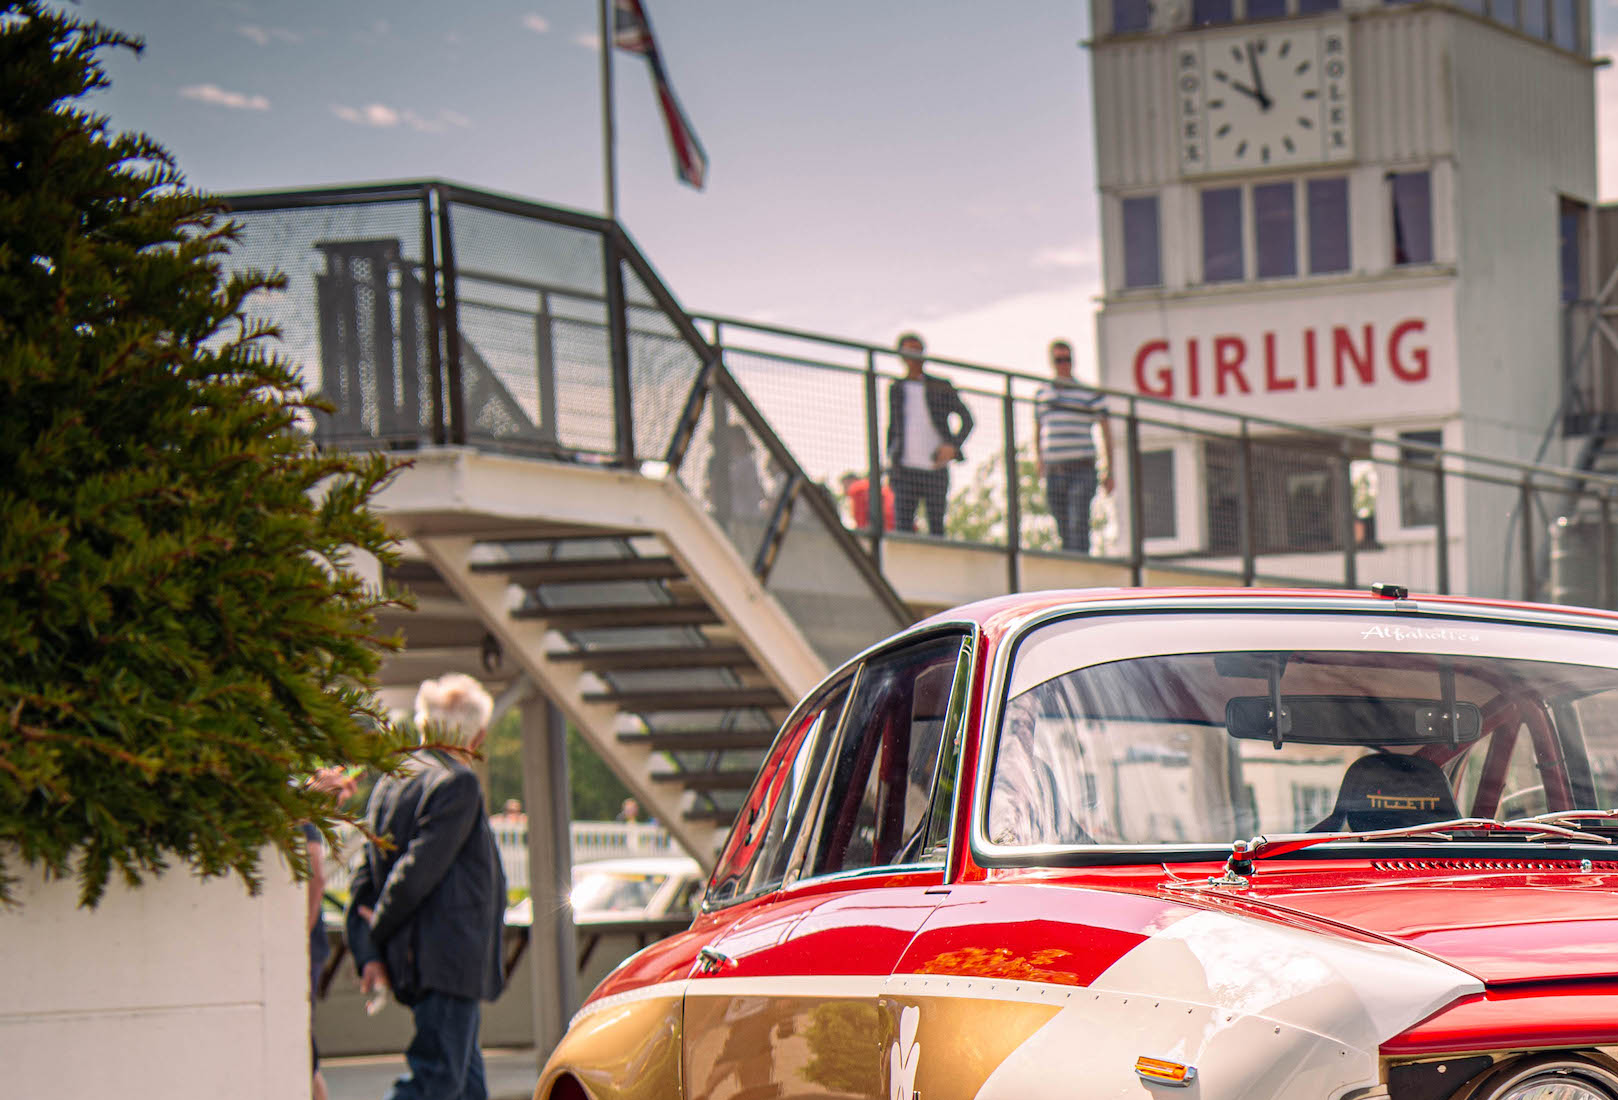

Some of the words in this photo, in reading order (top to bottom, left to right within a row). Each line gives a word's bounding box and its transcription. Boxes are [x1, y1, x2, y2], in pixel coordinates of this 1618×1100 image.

[1180, 52, 1199, 161] ROLEX
[1326, 35, 1344, 146] ROLEX
[1132, 319, 1430, 400] GIRLING
